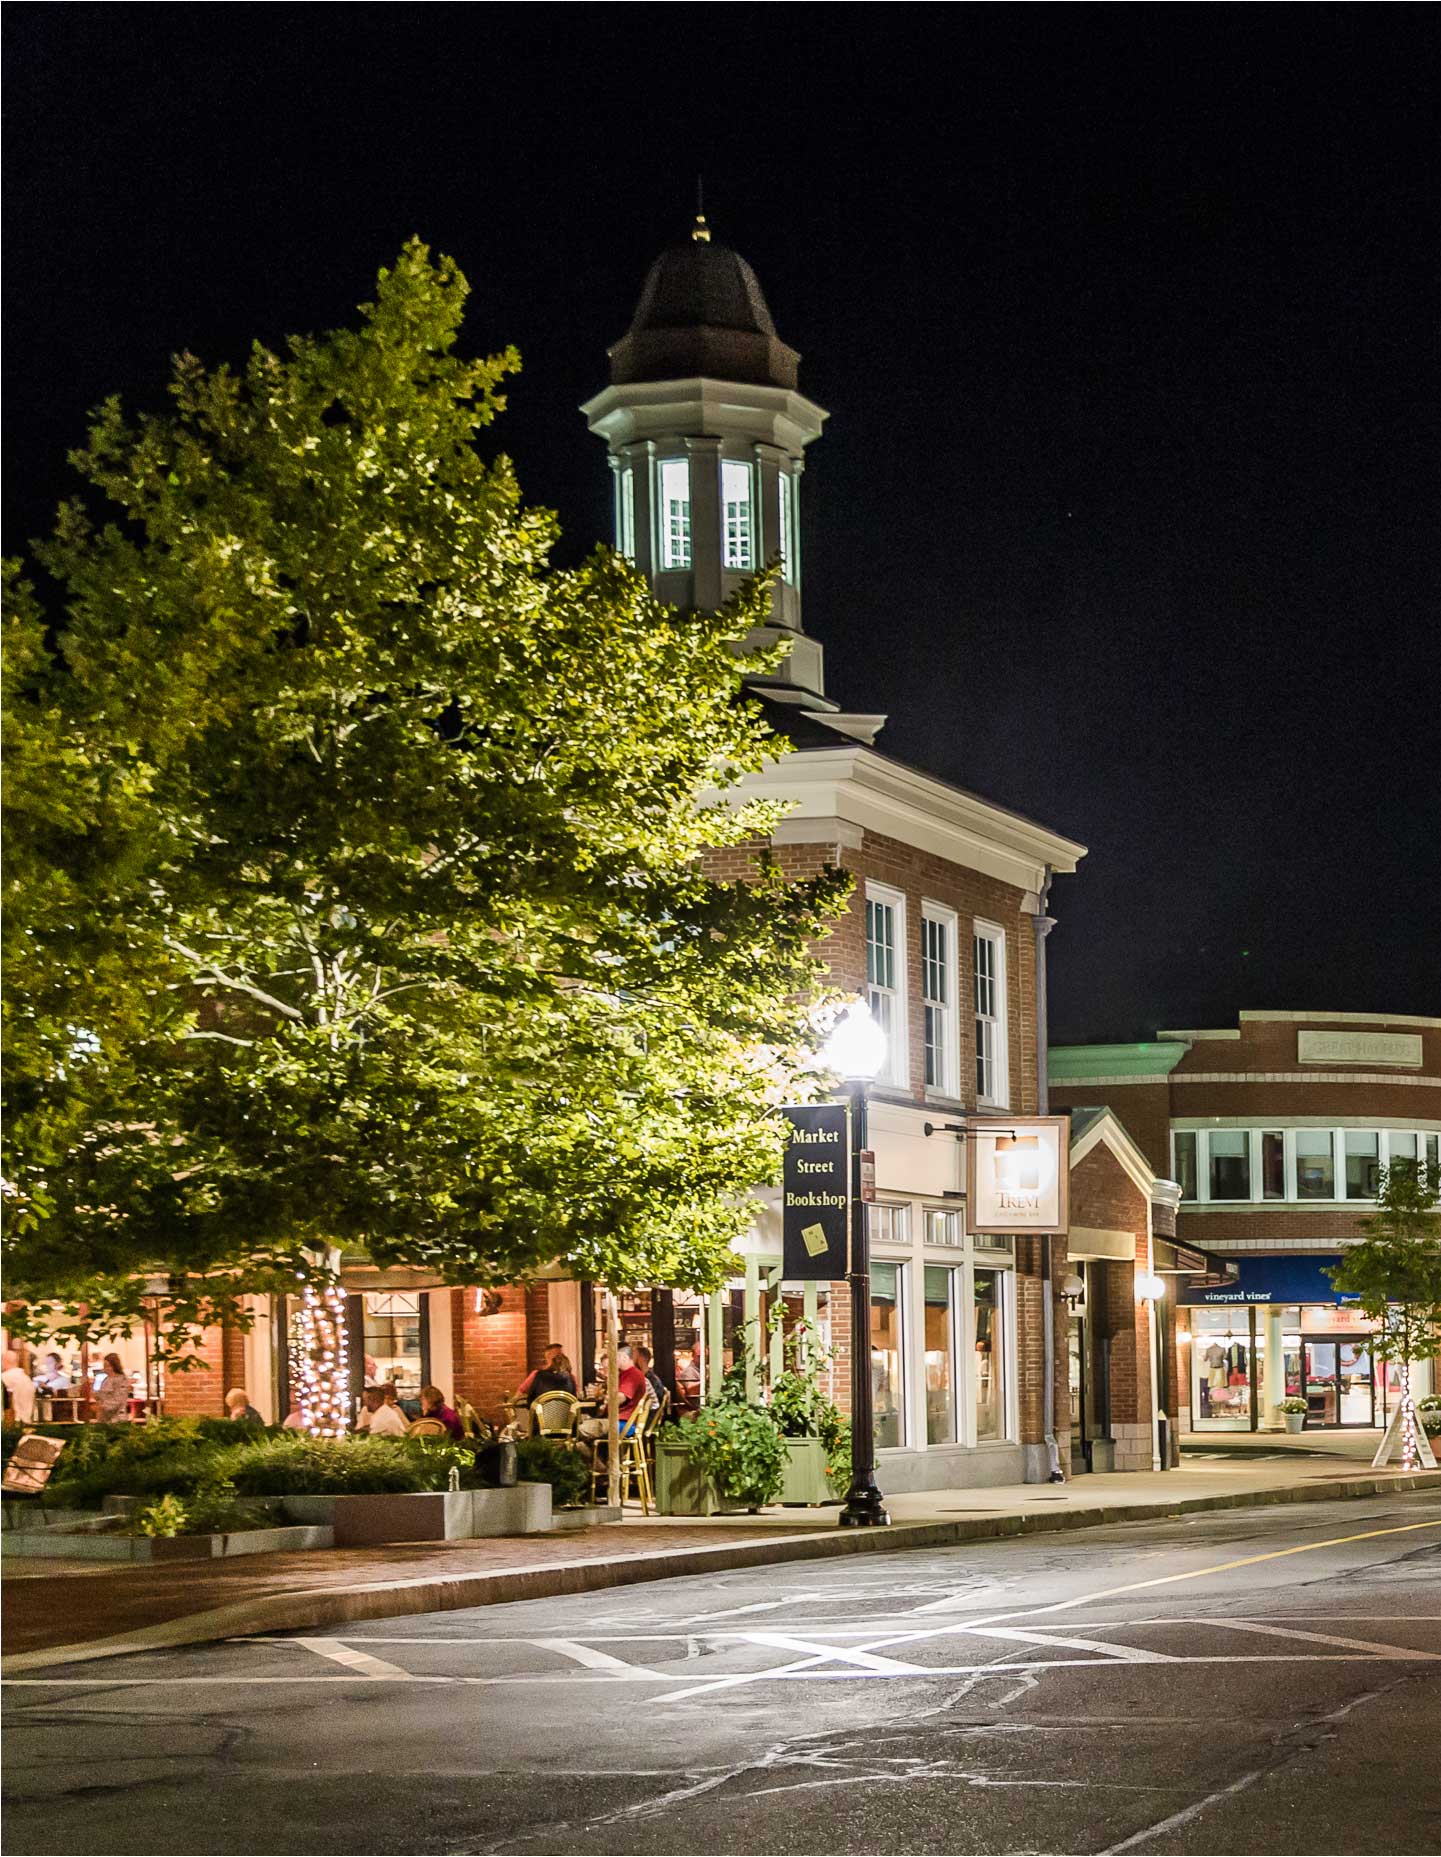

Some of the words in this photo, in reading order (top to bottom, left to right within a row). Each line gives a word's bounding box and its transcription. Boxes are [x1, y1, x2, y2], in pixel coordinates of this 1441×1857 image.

[792, 1128, 839, 1143] Market
[797, 1159, 834, 1173] Street
[786, 1191, 846, 1209] Bookshop
[1205, 1291, 1244, 1303] vineyard
[1246, 1291, 1271, 1300] vines
